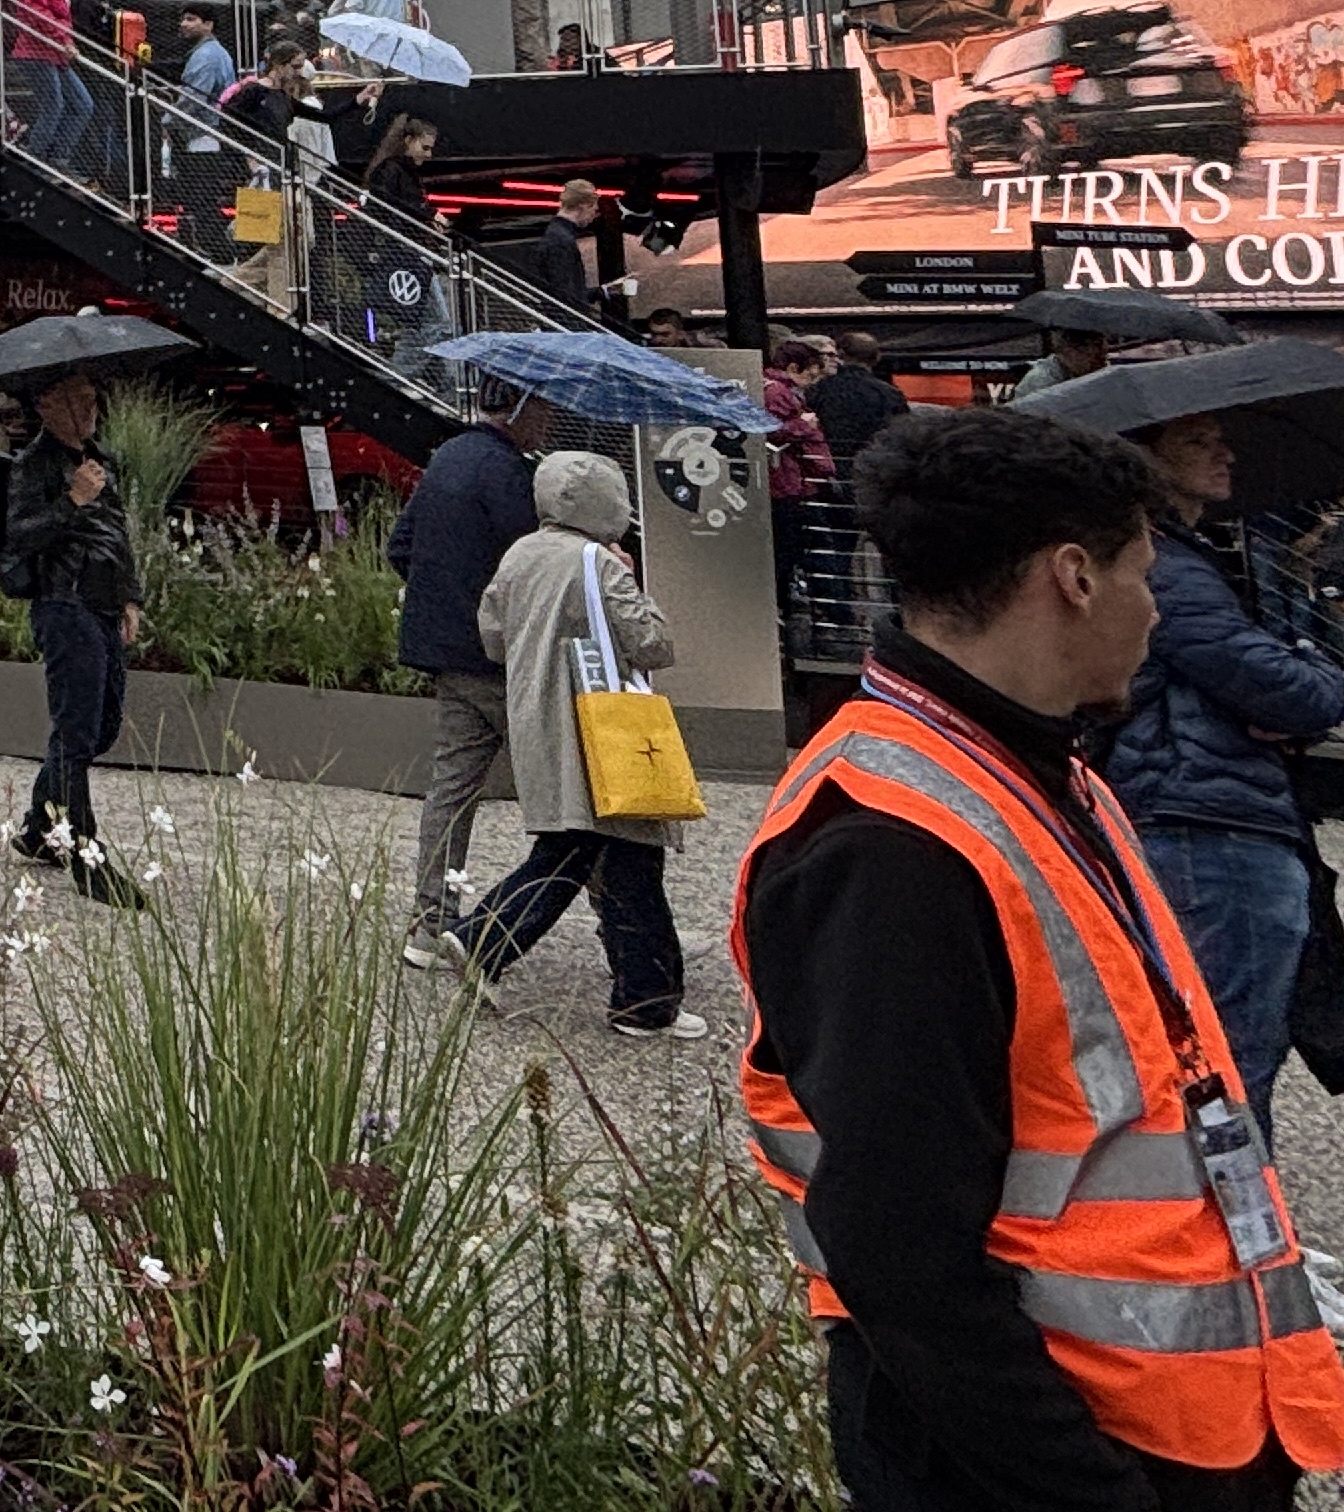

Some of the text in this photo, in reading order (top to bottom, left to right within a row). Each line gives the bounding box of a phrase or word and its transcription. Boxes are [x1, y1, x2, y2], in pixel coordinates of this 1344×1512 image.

[982, 162, 1233, 234] TURNS
[914, 256, 974, 268] LONDON
[1063, 241, 1207, 290] AND
[922, 283, 940, 294] AT
[942, 283, 977, 294] BMW
[980, 283, 1020, 295] WELT
